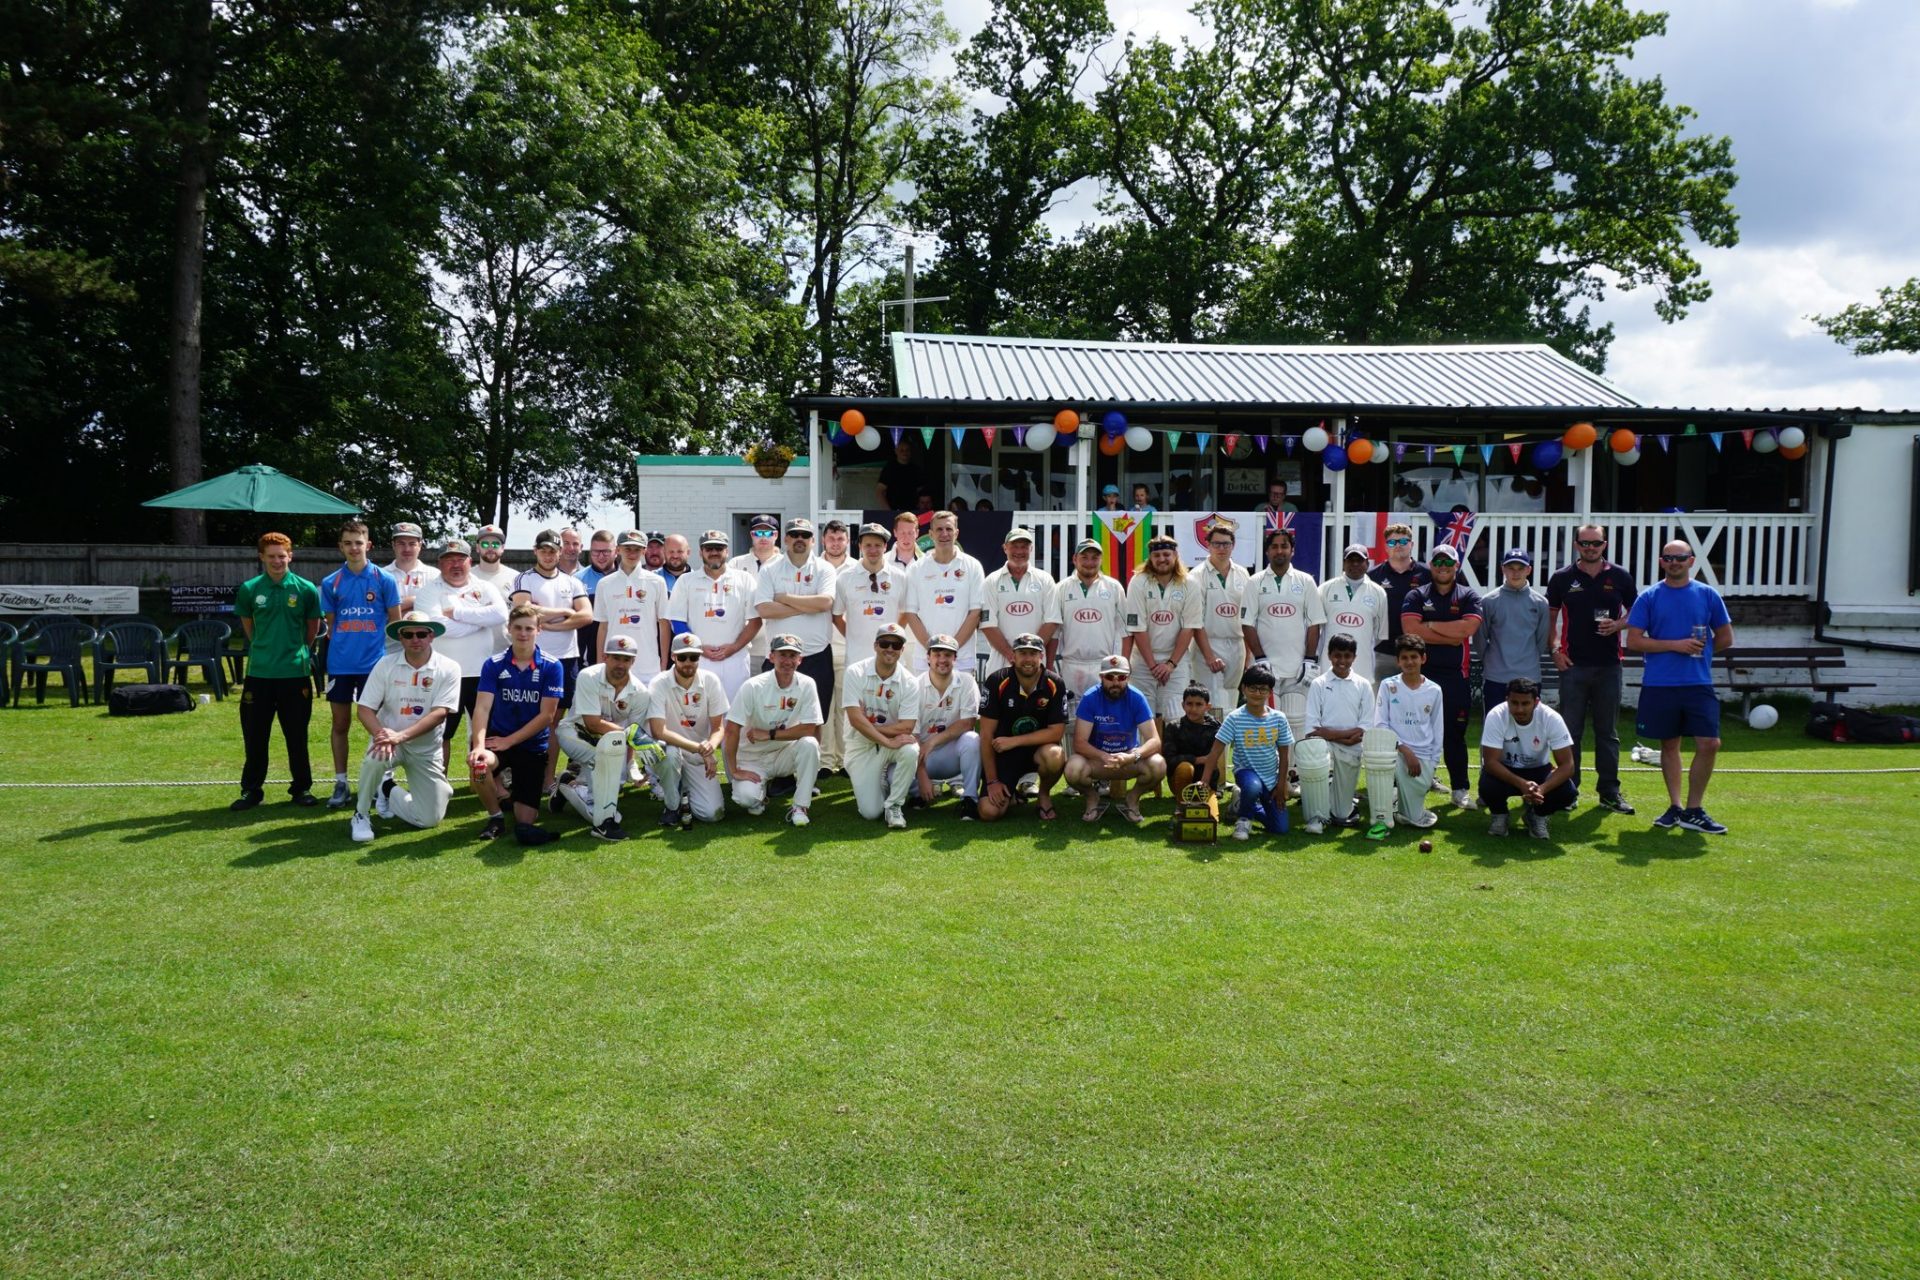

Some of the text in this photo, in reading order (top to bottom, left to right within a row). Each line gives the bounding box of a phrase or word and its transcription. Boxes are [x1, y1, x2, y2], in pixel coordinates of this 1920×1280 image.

[180, 586, 234, 595] PHOENIX
[0, 592, 39, 606] Tutbury
[44, 593, 61, 604] Tea
[63, 593, 93, 606] Room
[340, 606, 374, 617] oppo
[1010, 604, 1030, 613] KIA
[1219, 606, 1236, 615] KIA
[1272, 606, 1292, 615] KIA
[1079, 611, 1098, 620] KIA
[1155, 613, 1172, 622] KIA
[1340, 615, 1360, 625] KIA
[502, 688, 540, 703] ENGLAND
[1244, 727, 1278, 748] GAP
